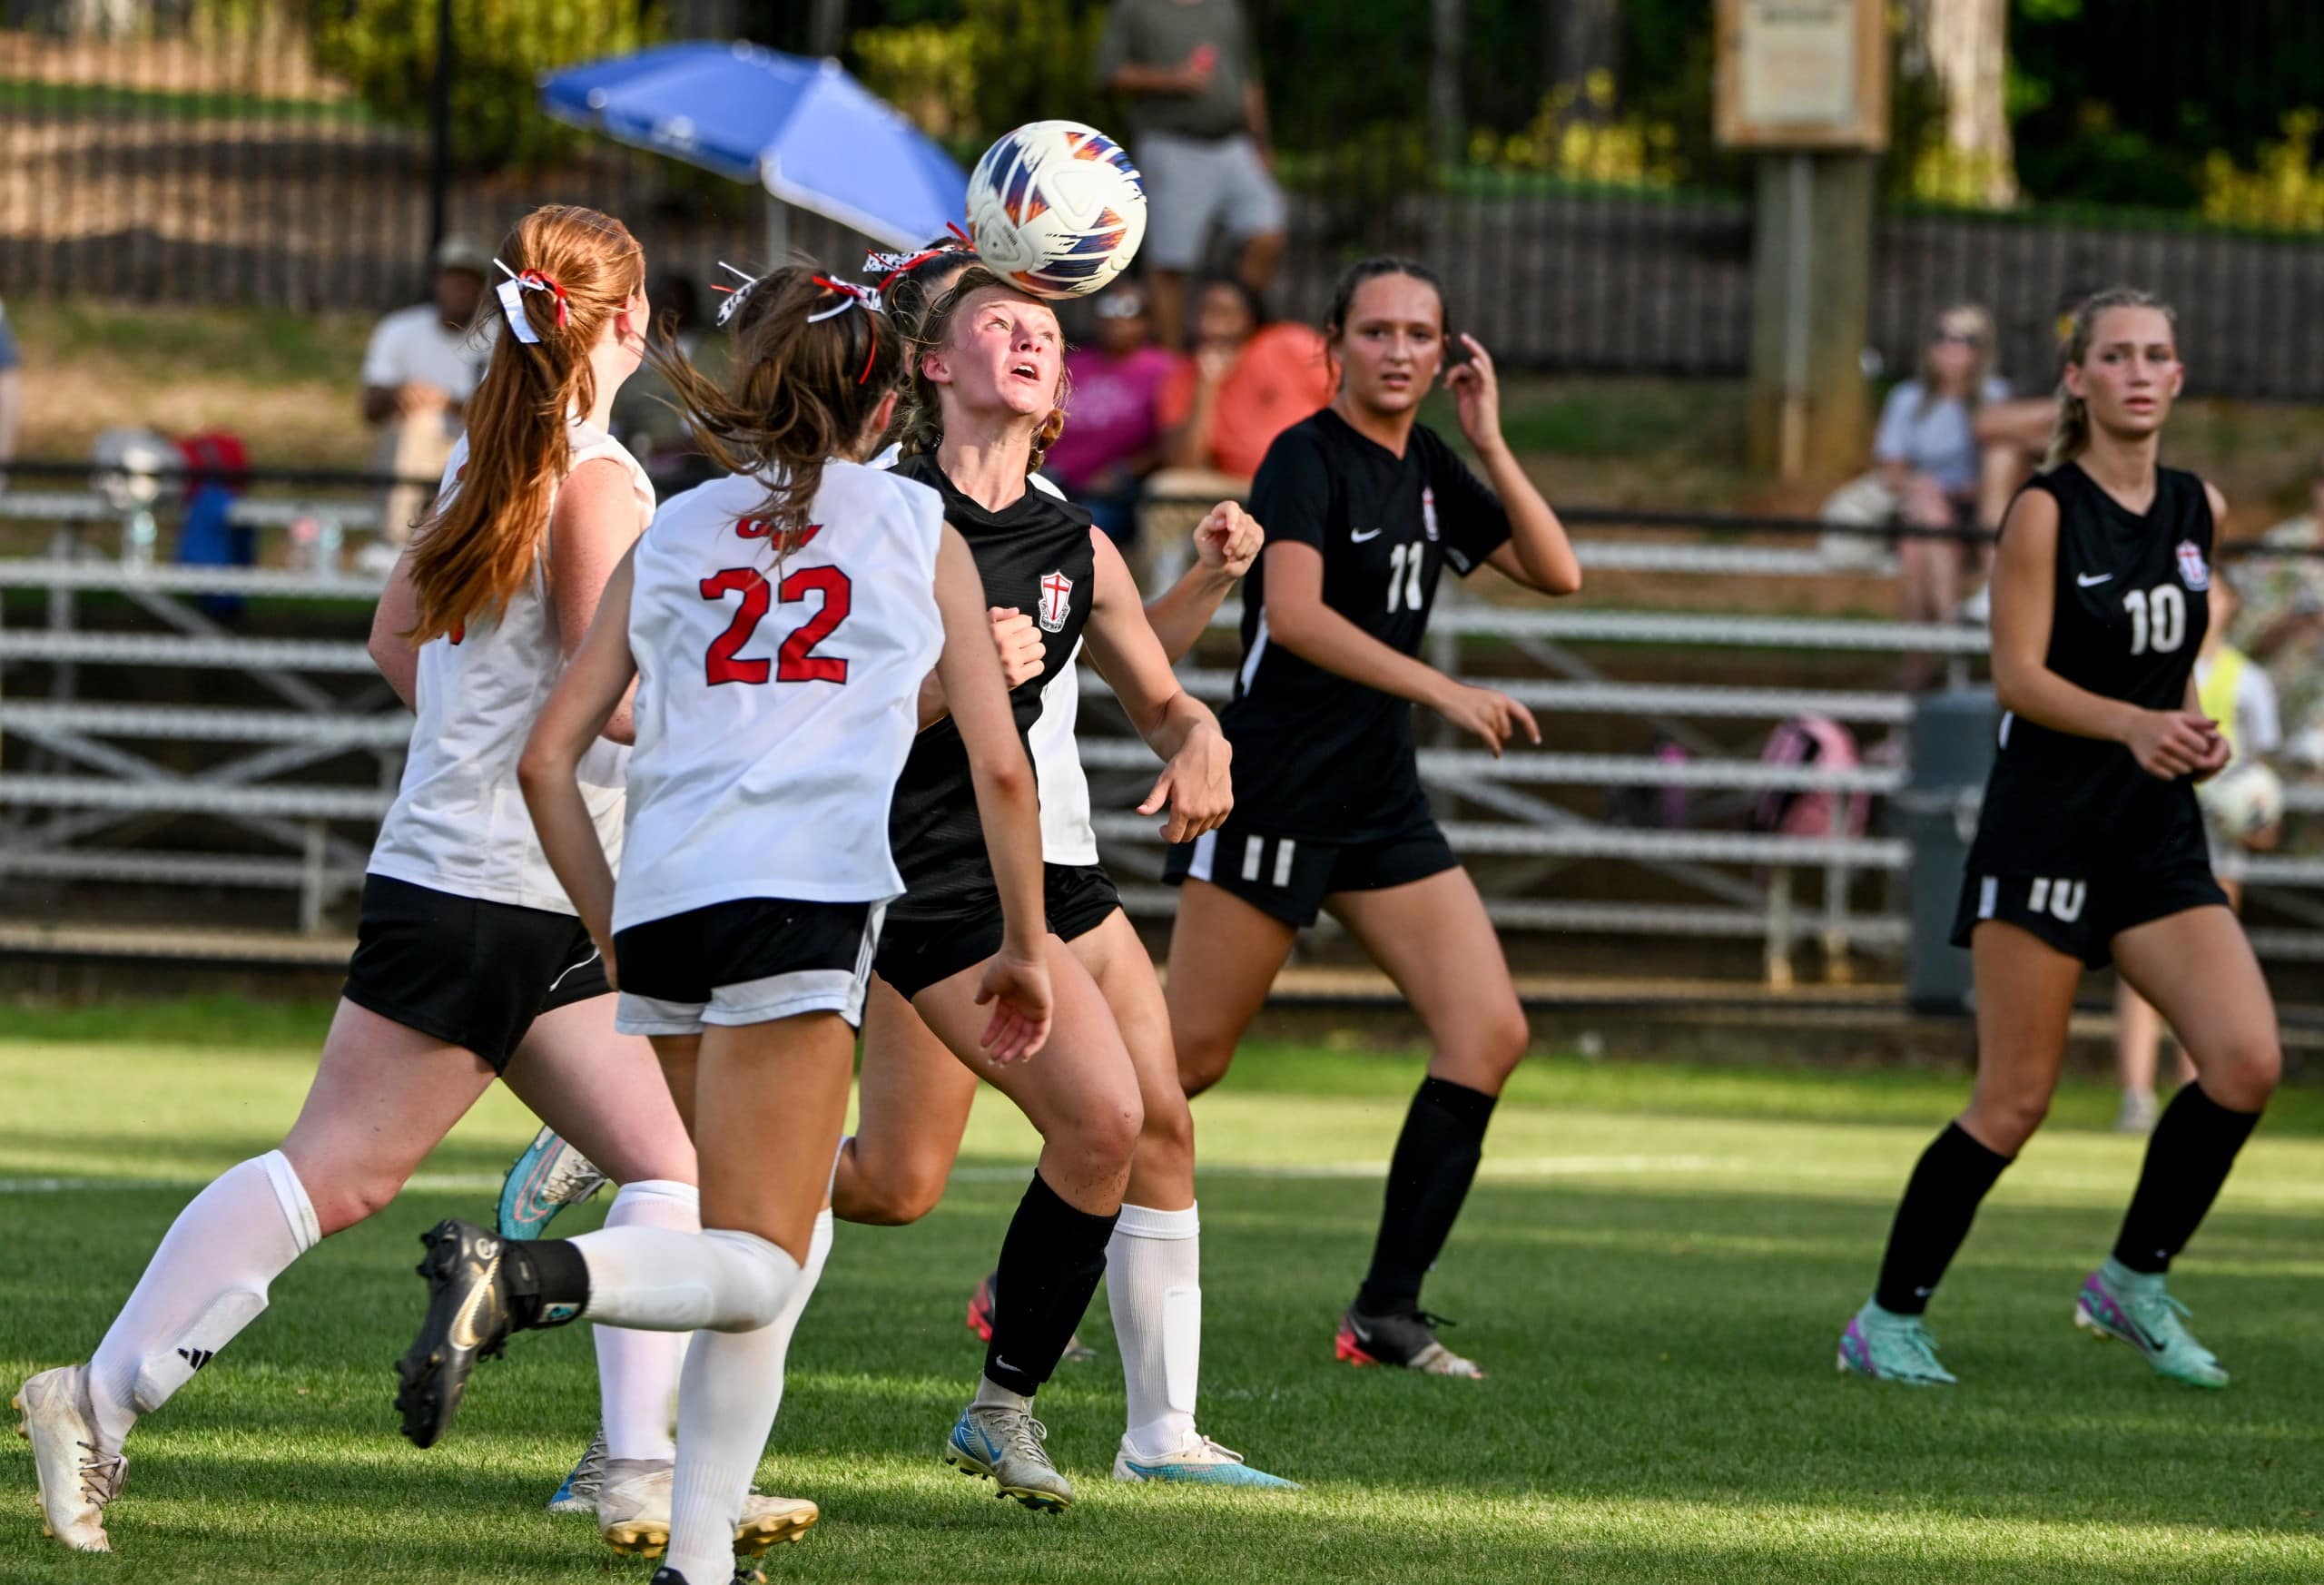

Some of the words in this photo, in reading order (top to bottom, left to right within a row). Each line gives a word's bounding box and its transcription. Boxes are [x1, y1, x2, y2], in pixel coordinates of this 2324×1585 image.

[1387, 541, 1423, 613] 11
[699, 565, 852, 687] 22
[2122, 584, 2186, 655] 10
[1242, 836, 1295, 887] 11
